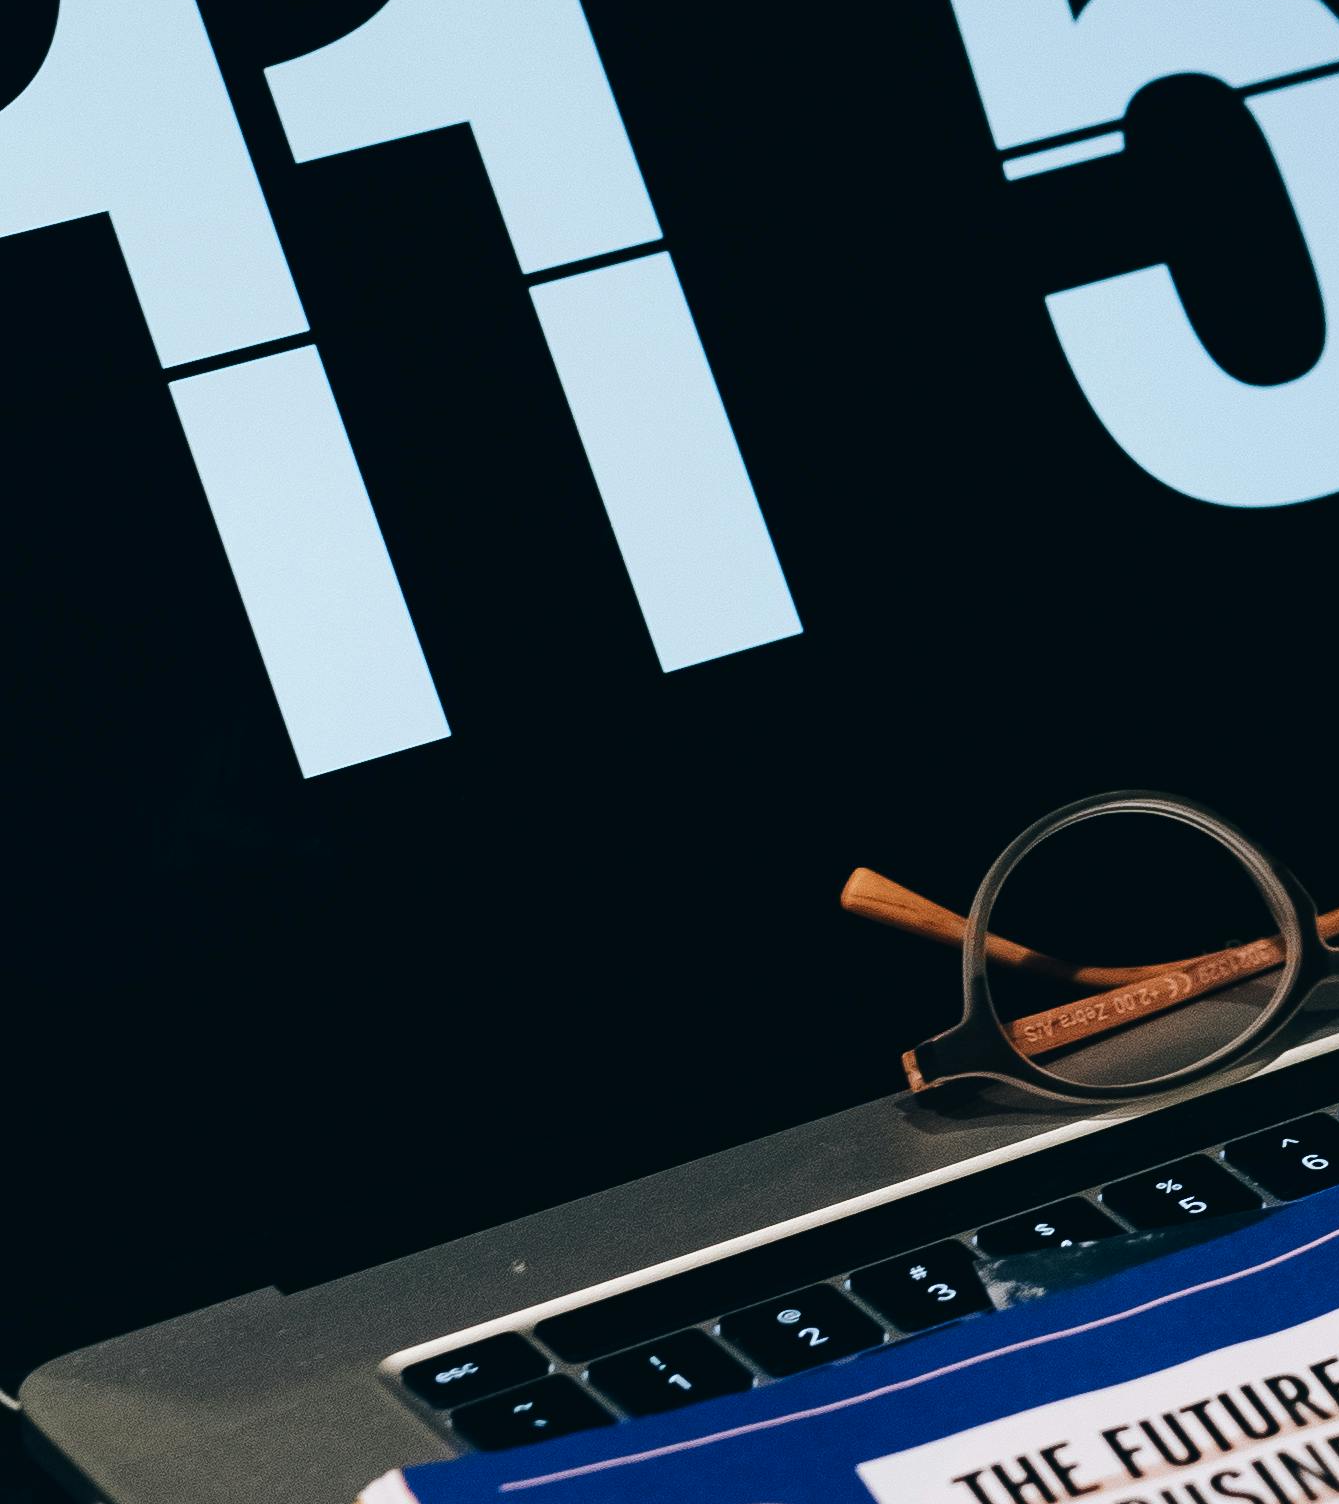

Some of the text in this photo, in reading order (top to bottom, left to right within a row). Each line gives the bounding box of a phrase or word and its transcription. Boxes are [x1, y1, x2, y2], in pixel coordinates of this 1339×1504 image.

[1061, 1002, 1107, 1030] Zebra
[1301, 1153, 1330, 1172] 6
[1156, 1178, 1183, 1195] %
[1177, 1196, 1208, 1216] 5
[909, 1263, 929, 1282] #
[927, 1282, 958, 1303] 3
[775, 1307, 802, 1326] @
[798, 1326, 829, 1348] 2
[434, 1360, 481, 1385] esc
[667, 1373, 693, 1392] 1
